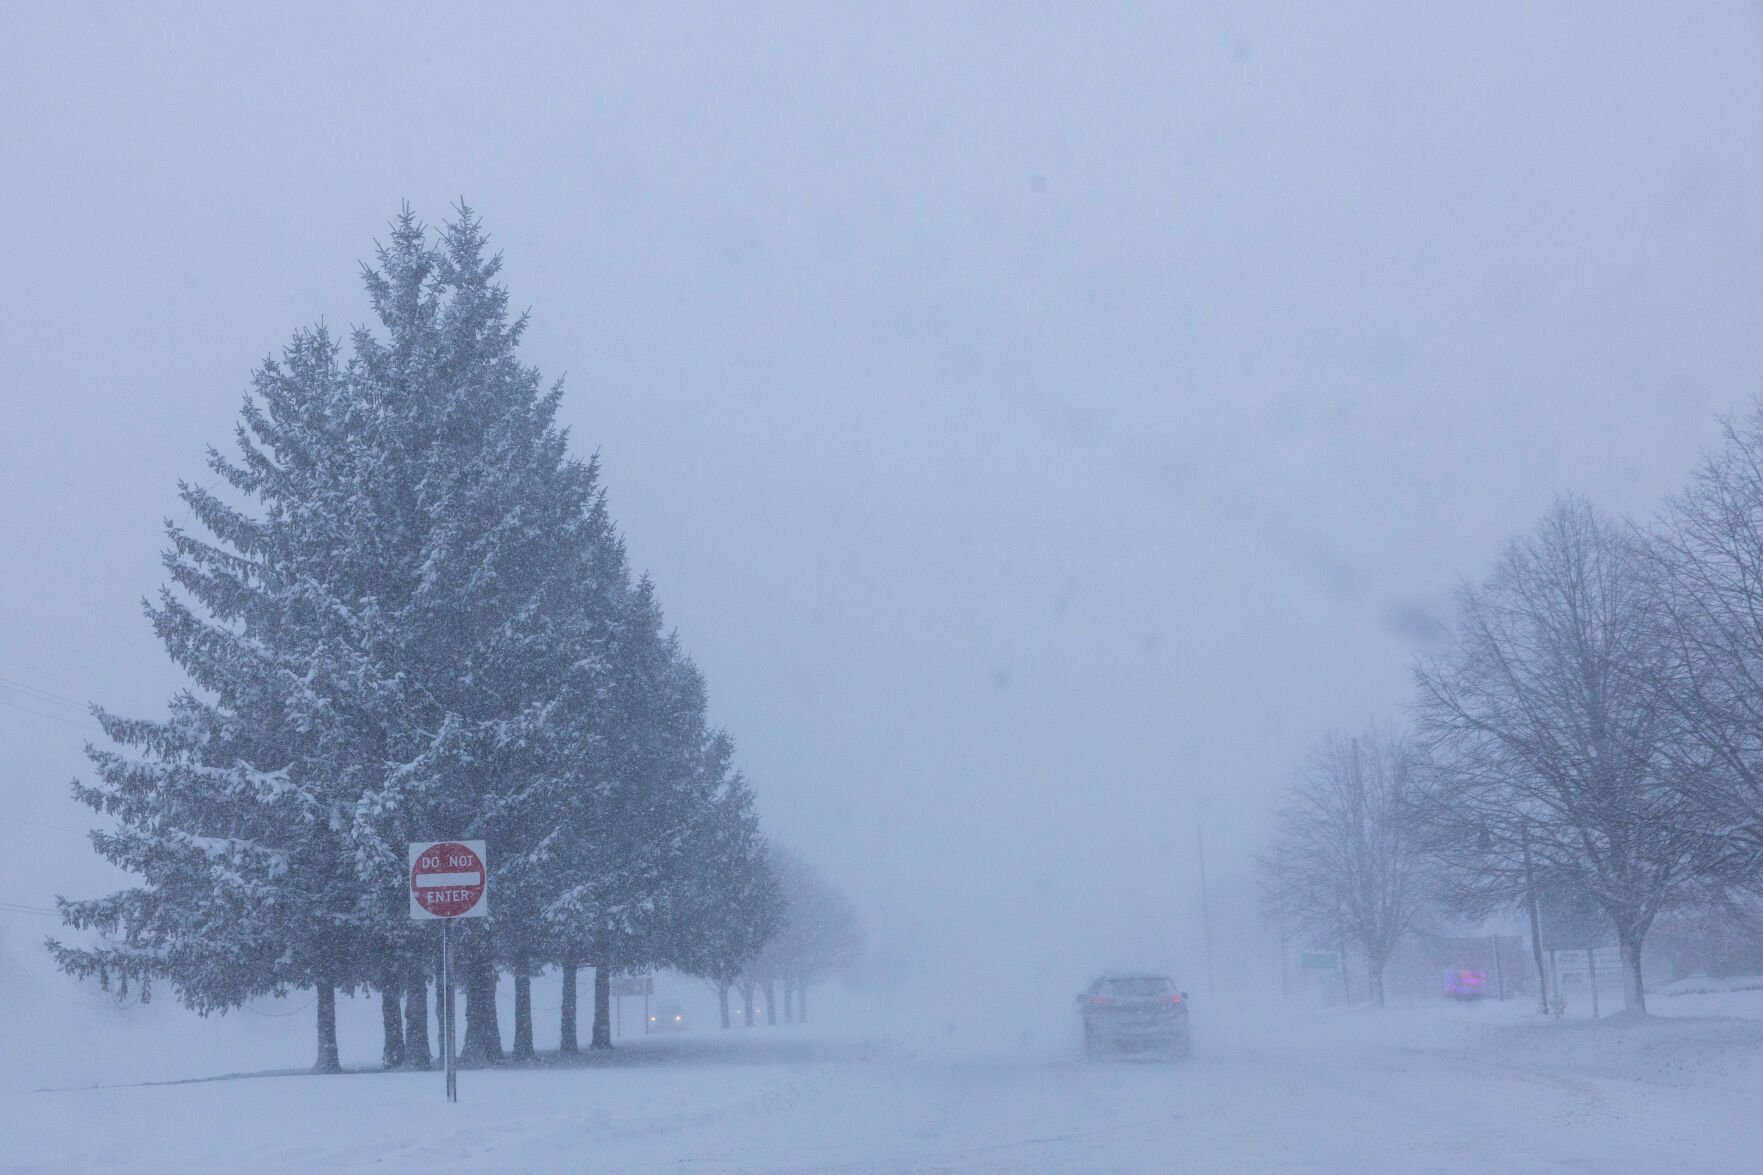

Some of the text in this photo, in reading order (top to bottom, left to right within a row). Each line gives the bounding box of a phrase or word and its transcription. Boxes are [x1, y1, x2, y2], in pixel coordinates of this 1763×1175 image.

[422, 855, 474, 868] DO NOT
[427, 890, 469, 903] ENTER
